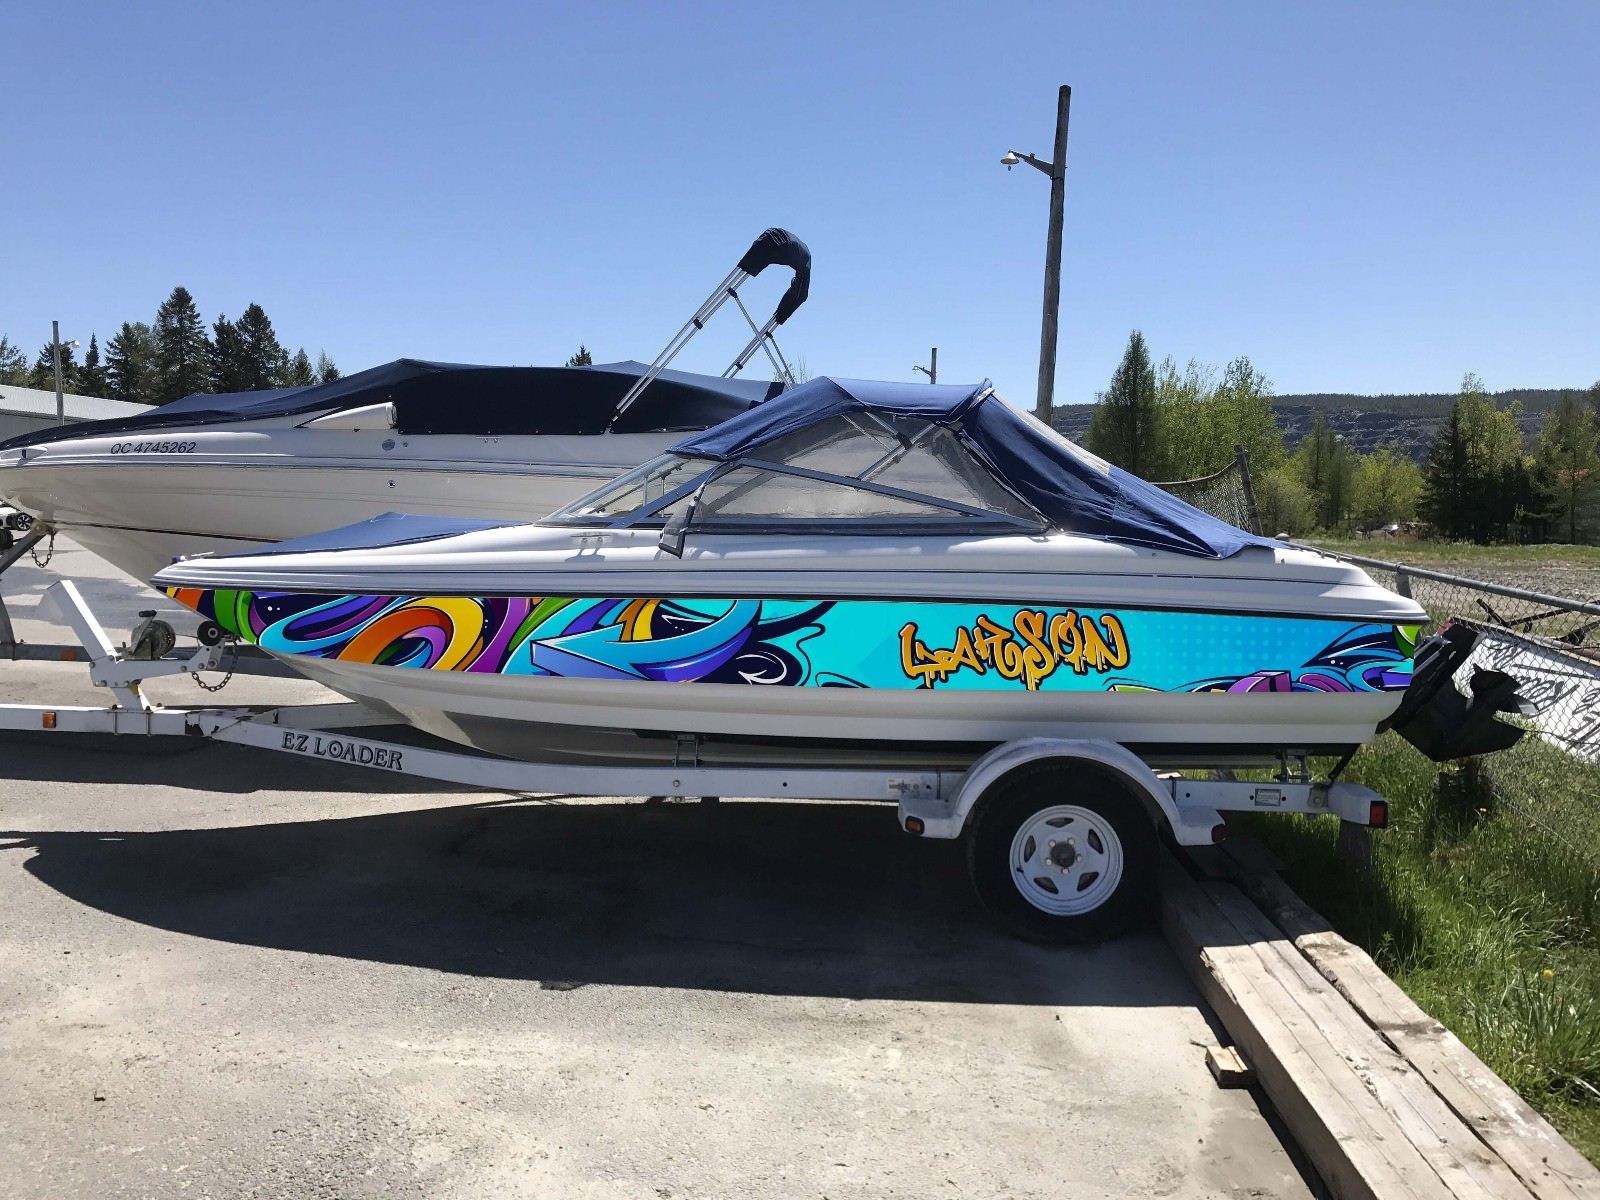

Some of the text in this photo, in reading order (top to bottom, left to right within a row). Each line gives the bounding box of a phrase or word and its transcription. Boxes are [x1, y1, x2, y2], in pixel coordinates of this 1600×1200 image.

[110, 441, 197, 455] QC 4745262
[898, 608, 1130, 691] LARSON
[281, 730, 404, 771] EZ LOADER
